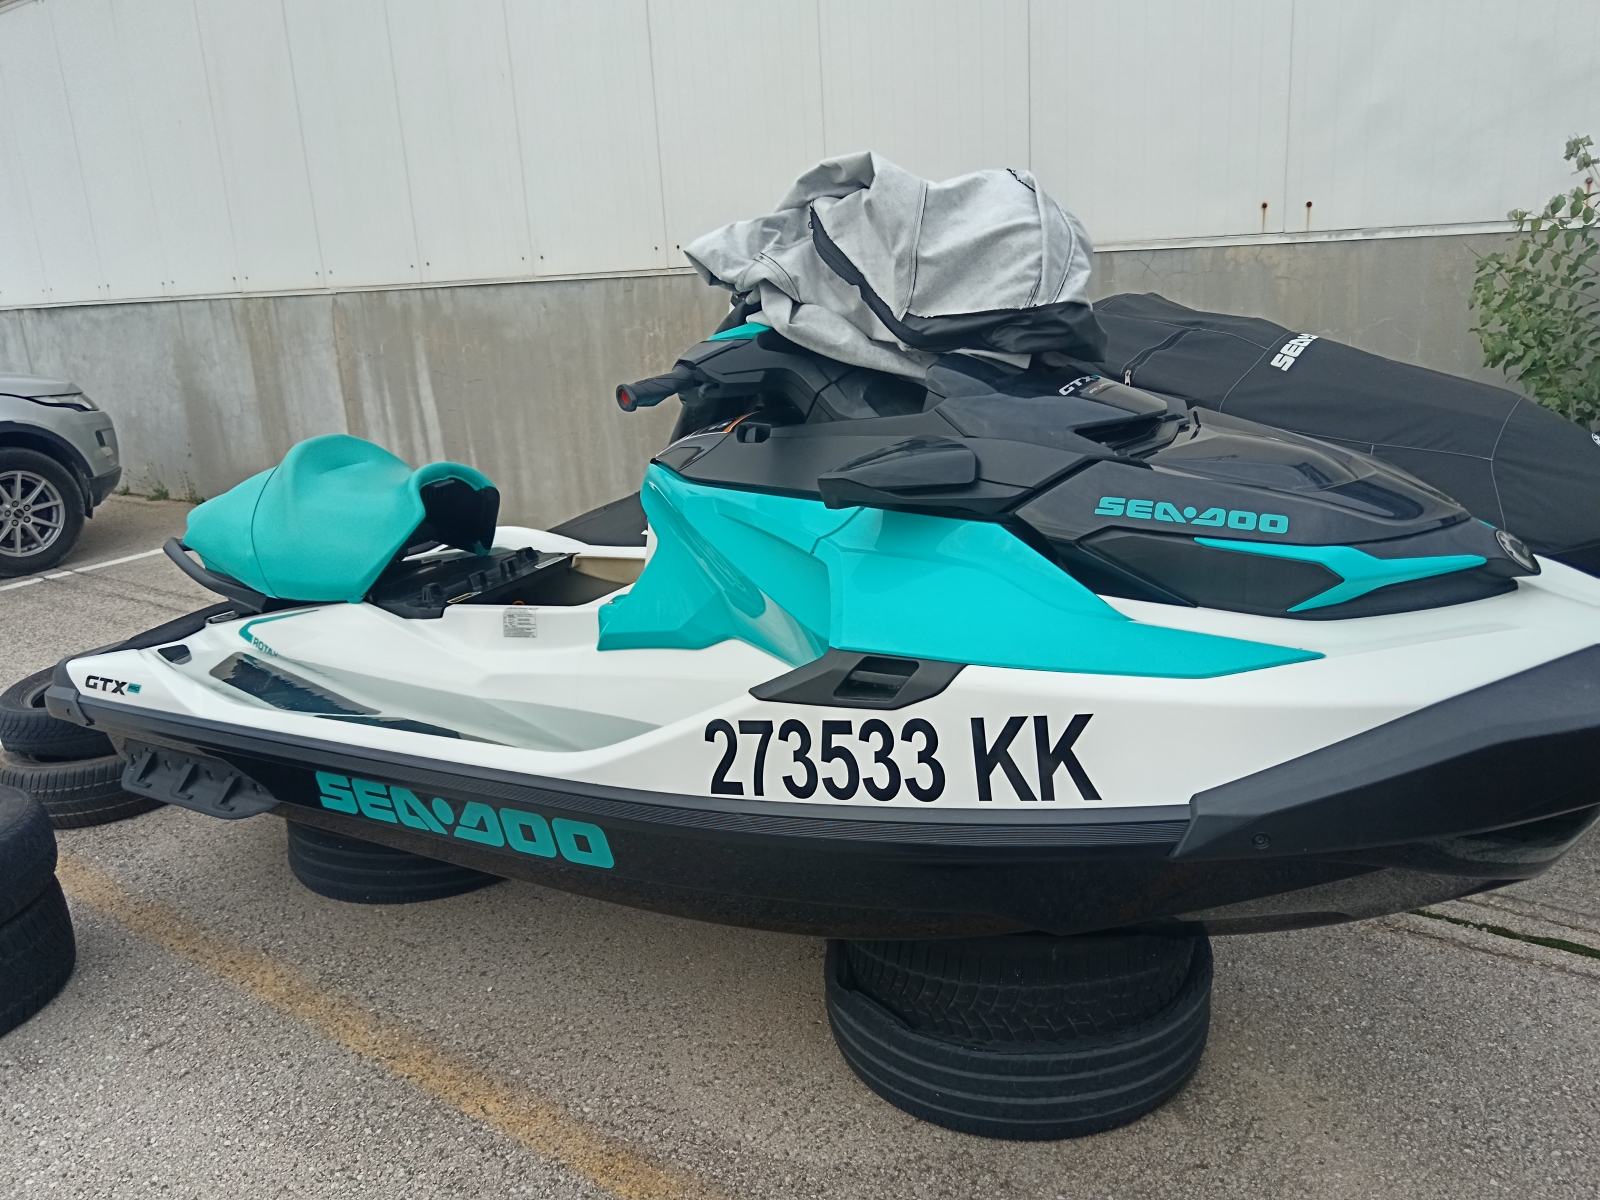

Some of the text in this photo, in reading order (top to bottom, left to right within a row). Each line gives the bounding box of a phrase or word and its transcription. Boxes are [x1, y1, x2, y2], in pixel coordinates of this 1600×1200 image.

[85, 674, 128, 696] GTX
[704, 713, 1102, 802] 273533 KK
